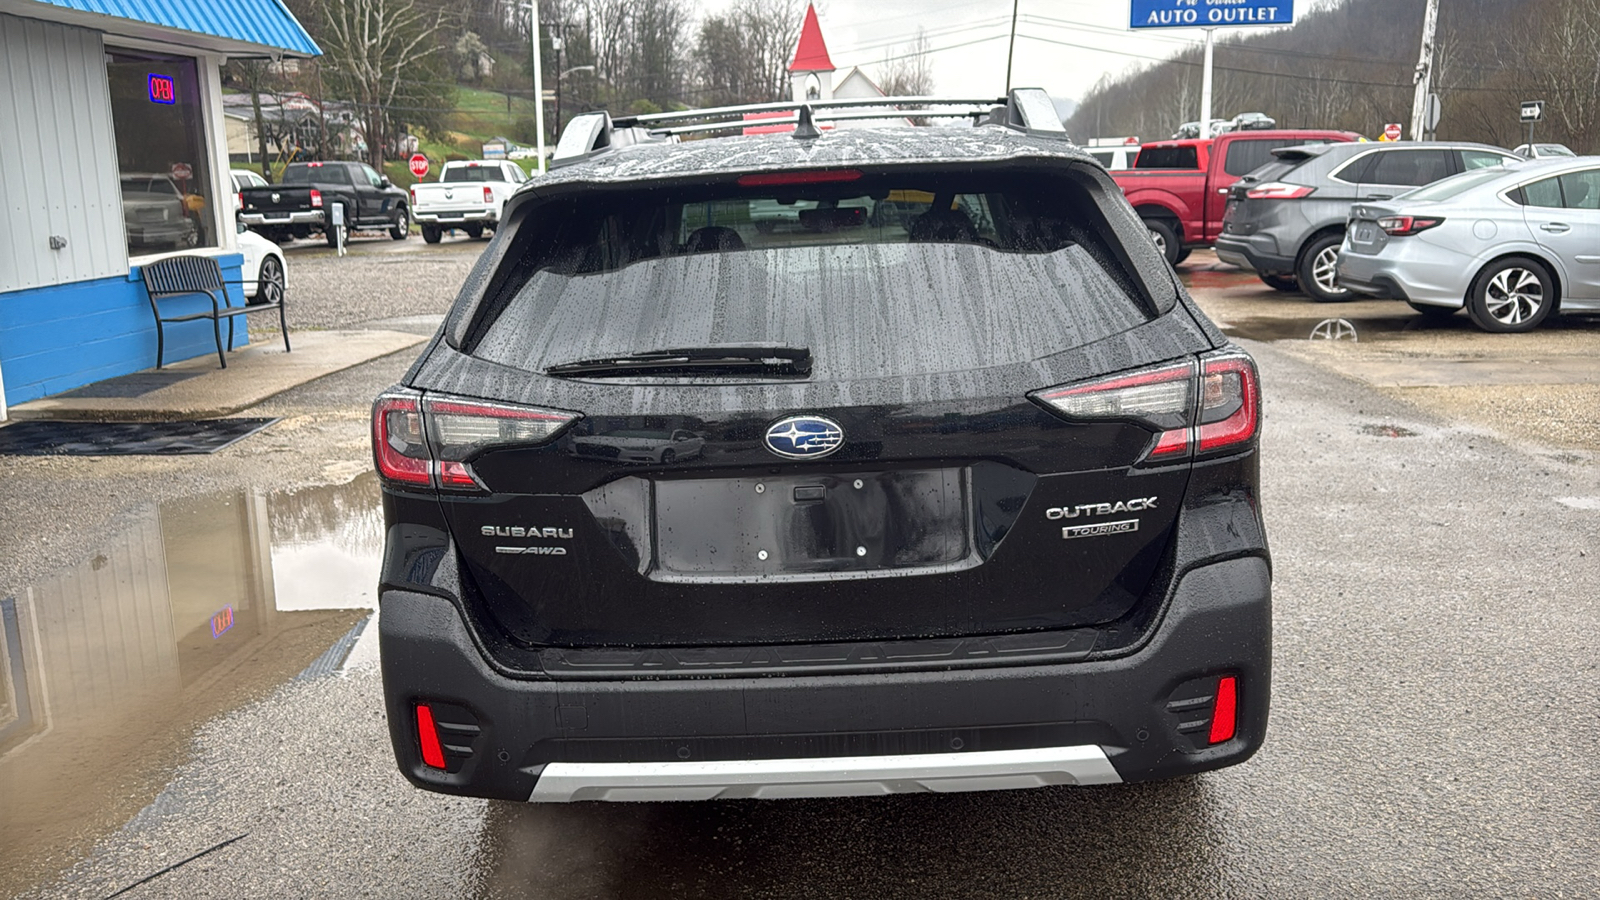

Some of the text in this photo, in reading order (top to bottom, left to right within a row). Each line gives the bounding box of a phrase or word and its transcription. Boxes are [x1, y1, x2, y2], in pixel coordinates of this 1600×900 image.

[1147, 7, 1277, 24] AUTO OUTLET
[151, 77, 174, 100] OPEN
[411, 160, 428, 170] STOP
[1046, 496, 1157, 520] OUTBACK
[481, 525, 573, 539] SUBARU
[1072, 523, 1130, 536] TOURING
[521, 546, 567, 555] AWD
